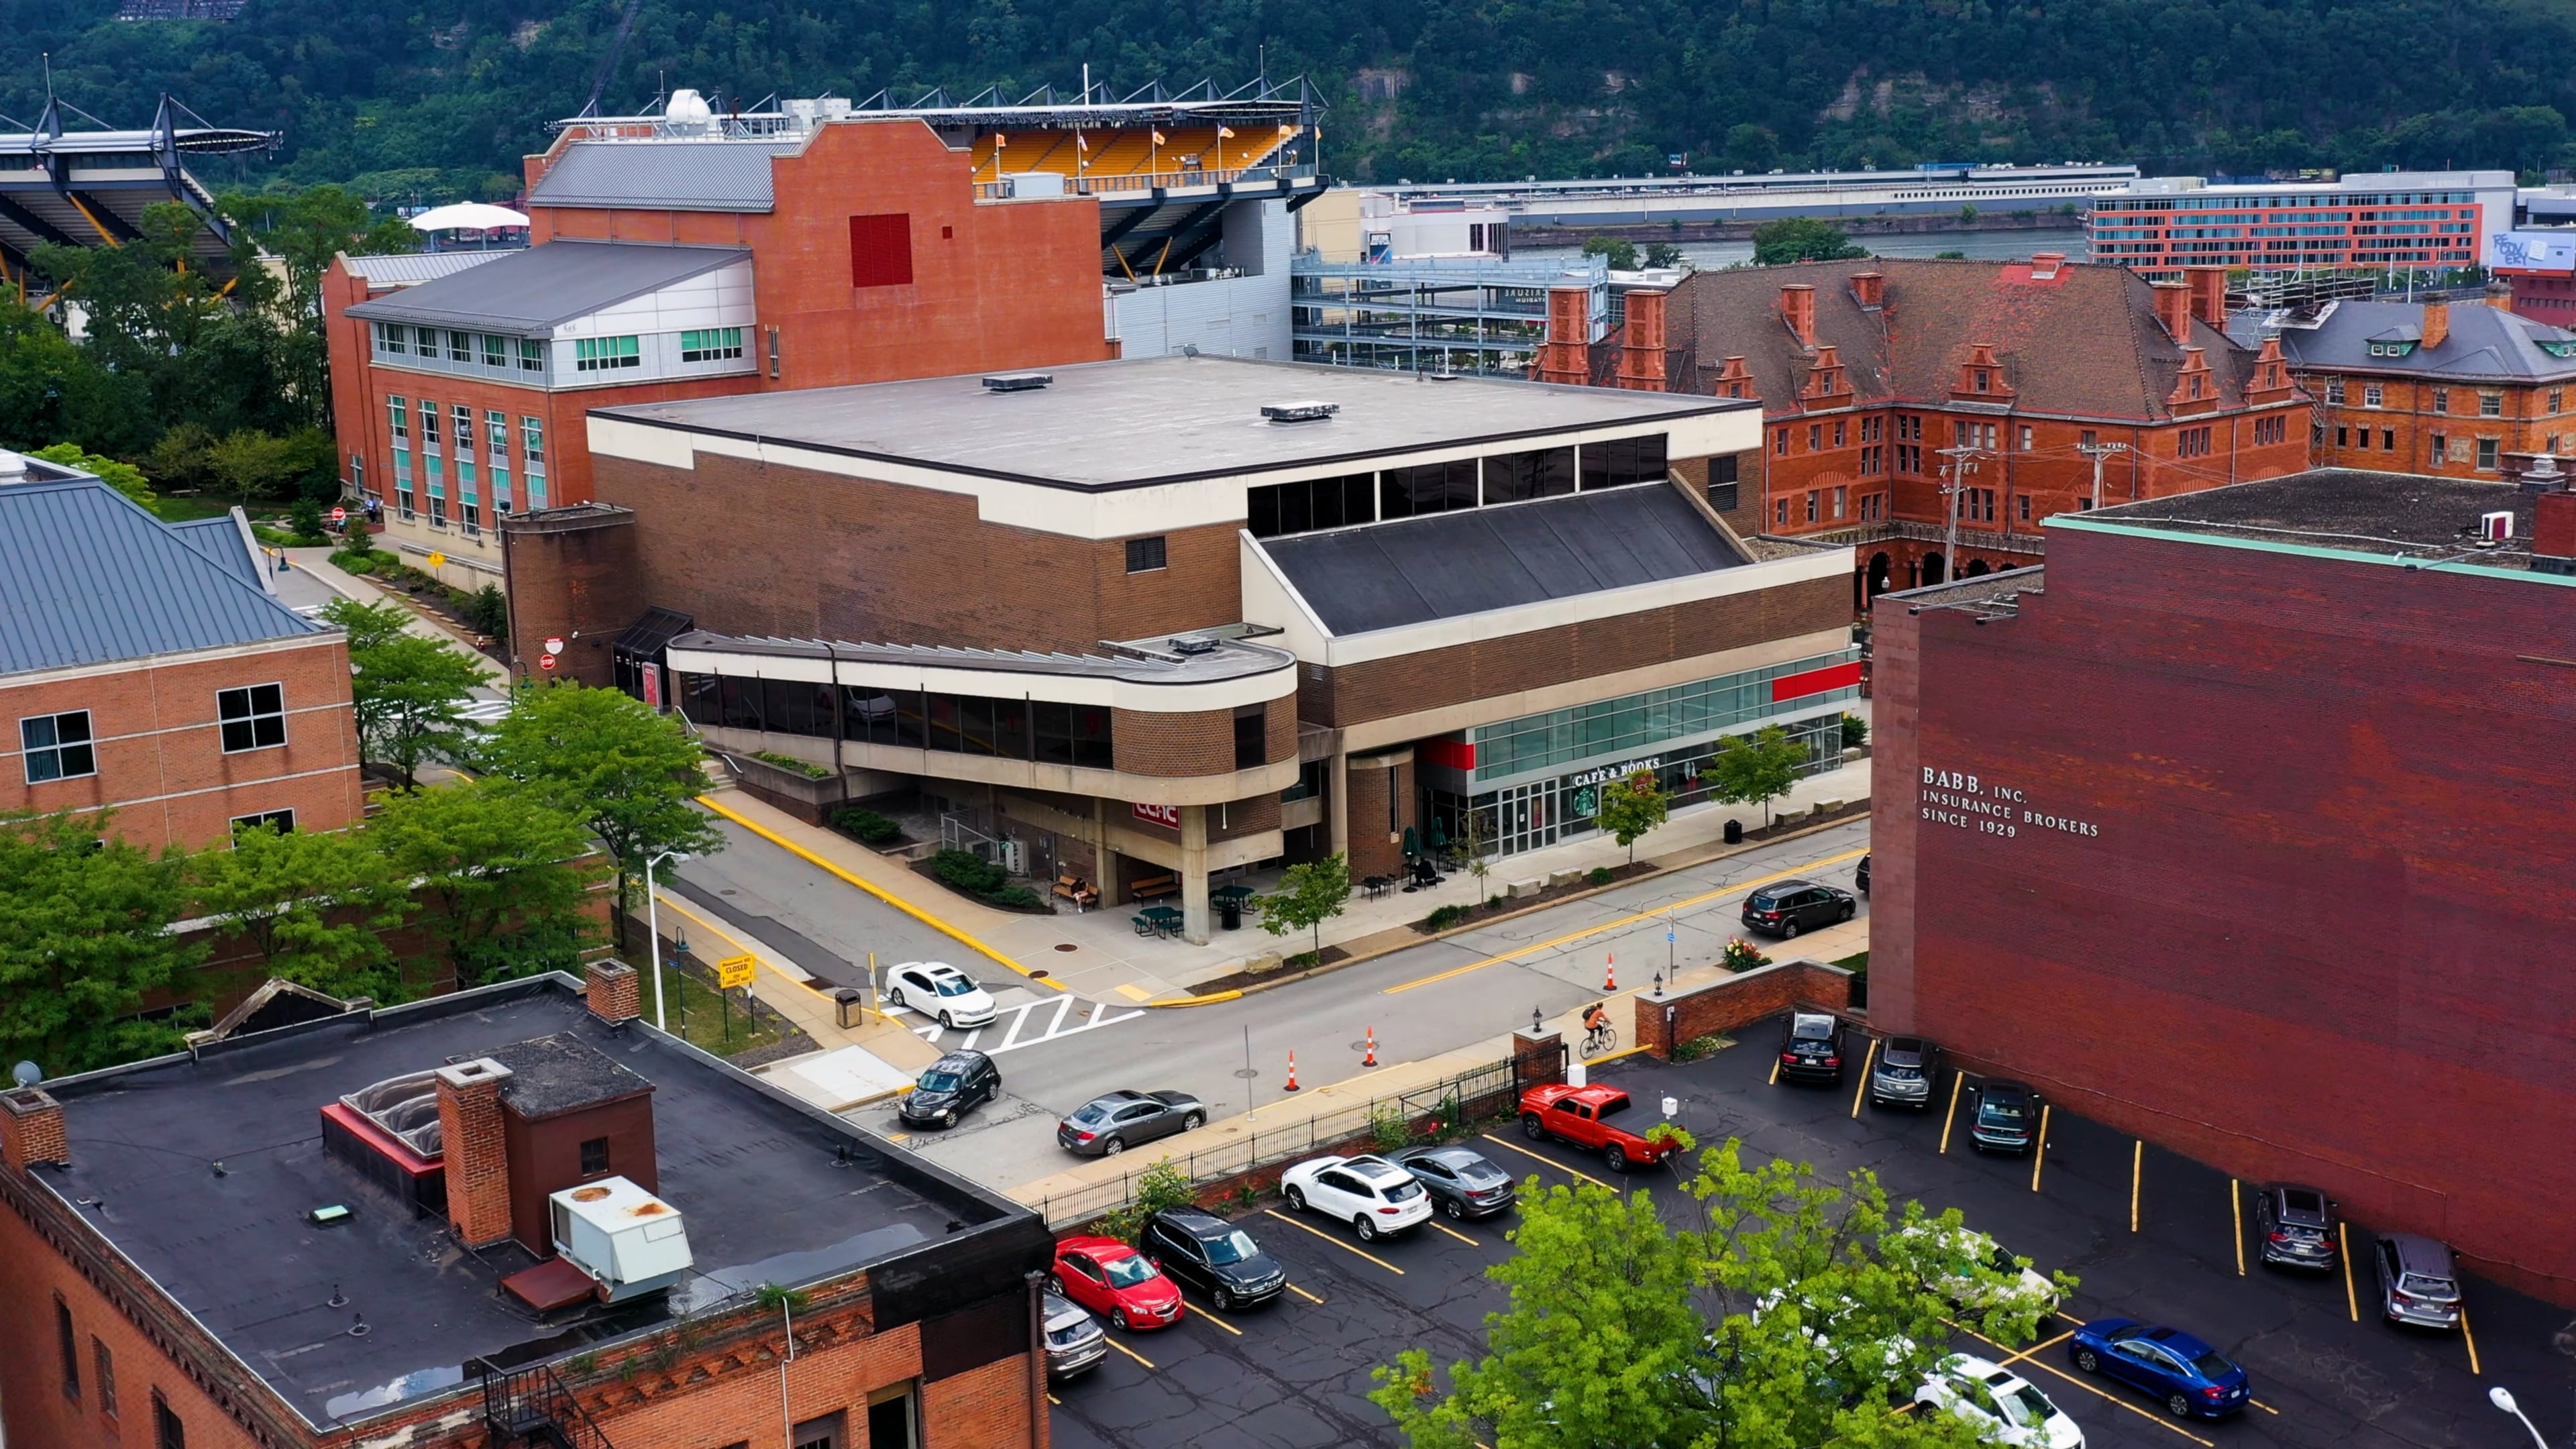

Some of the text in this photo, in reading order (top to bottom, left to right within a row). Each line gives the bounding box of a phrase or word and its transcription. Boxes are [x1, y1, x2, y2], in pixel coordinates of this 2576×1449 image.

[1574, 757, 1660, 787] CAFE & BOOKS
[1994, 786, 2028, 804] INC.
[1922, 808, 2017, 838] SINCE 1929
[1923, 790, 2099, 837] INSURANCE BROKERS
[726, 963, 748, 973] CLOSED
